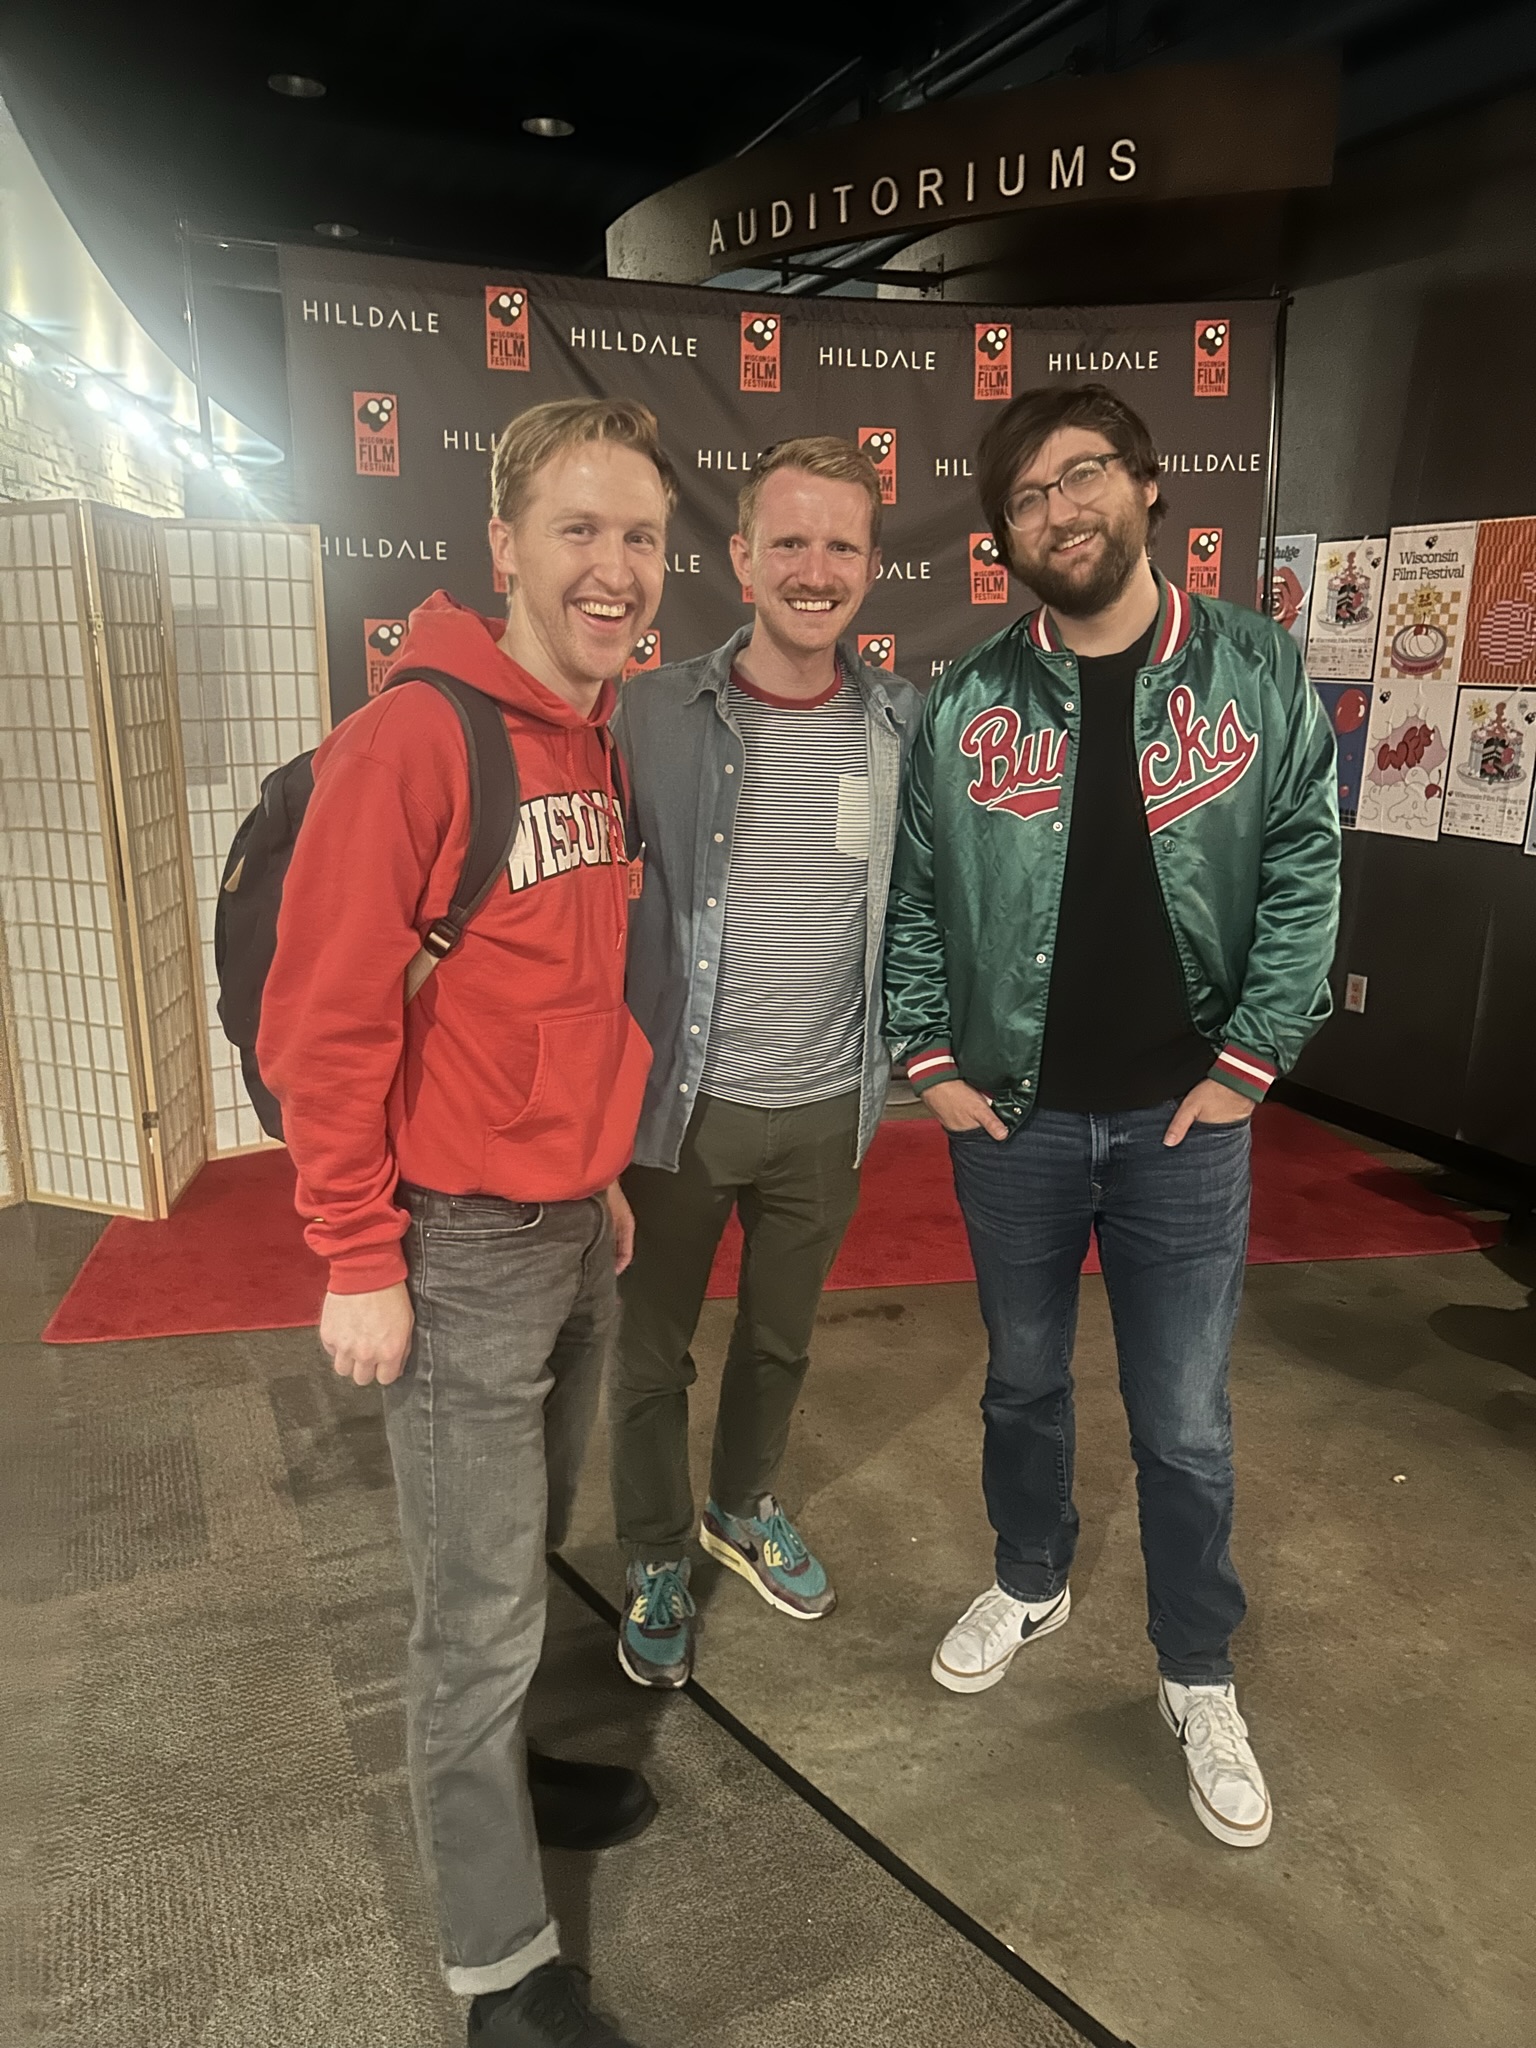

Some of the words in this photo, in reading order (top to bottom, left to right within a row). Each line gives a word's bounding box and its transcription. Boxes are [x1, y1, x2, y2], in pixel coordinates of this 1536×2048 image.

[709, 138, 1137, 256] AUDITORIUMS
[303, 300, 439, 333] HILLDALE
[490, 338, 526, 358] FILM
[571, 327, 697, 357] HILLDALE
[490, 356, 527, 367] FESTIVAL
[819, 347, 936, 371] HILLDALE
[1049, 350, 1159, 371] HILLDALE
[744, 362, 776, 380] FILM
[978, 371, 1008, 388] FILM
[1197, 368, 1225, 384] FILM
[744, 379, 777, 388] FESTIVAL
[1197, 384, 1225, 393] FESTIVAL
[977, 388, 1008, 397] FESTIVAL
[444, 430, 499, 451] HILL
[359, 444, 395, 464] FILM
[698, 450, 761, 470] HILL
[360, 462, 395, 472] FESTIVAL
[1399, 549, 1459, 565] Wisconsin
[1189, 572, 1217, 588] FILM
[1392, 567, 1419, 581] Film
[1419, 564, 1465, 580] Festival
[974, 577, 1004, 593] FILM
[974, 592, 1005, 601] FESTIVAL
